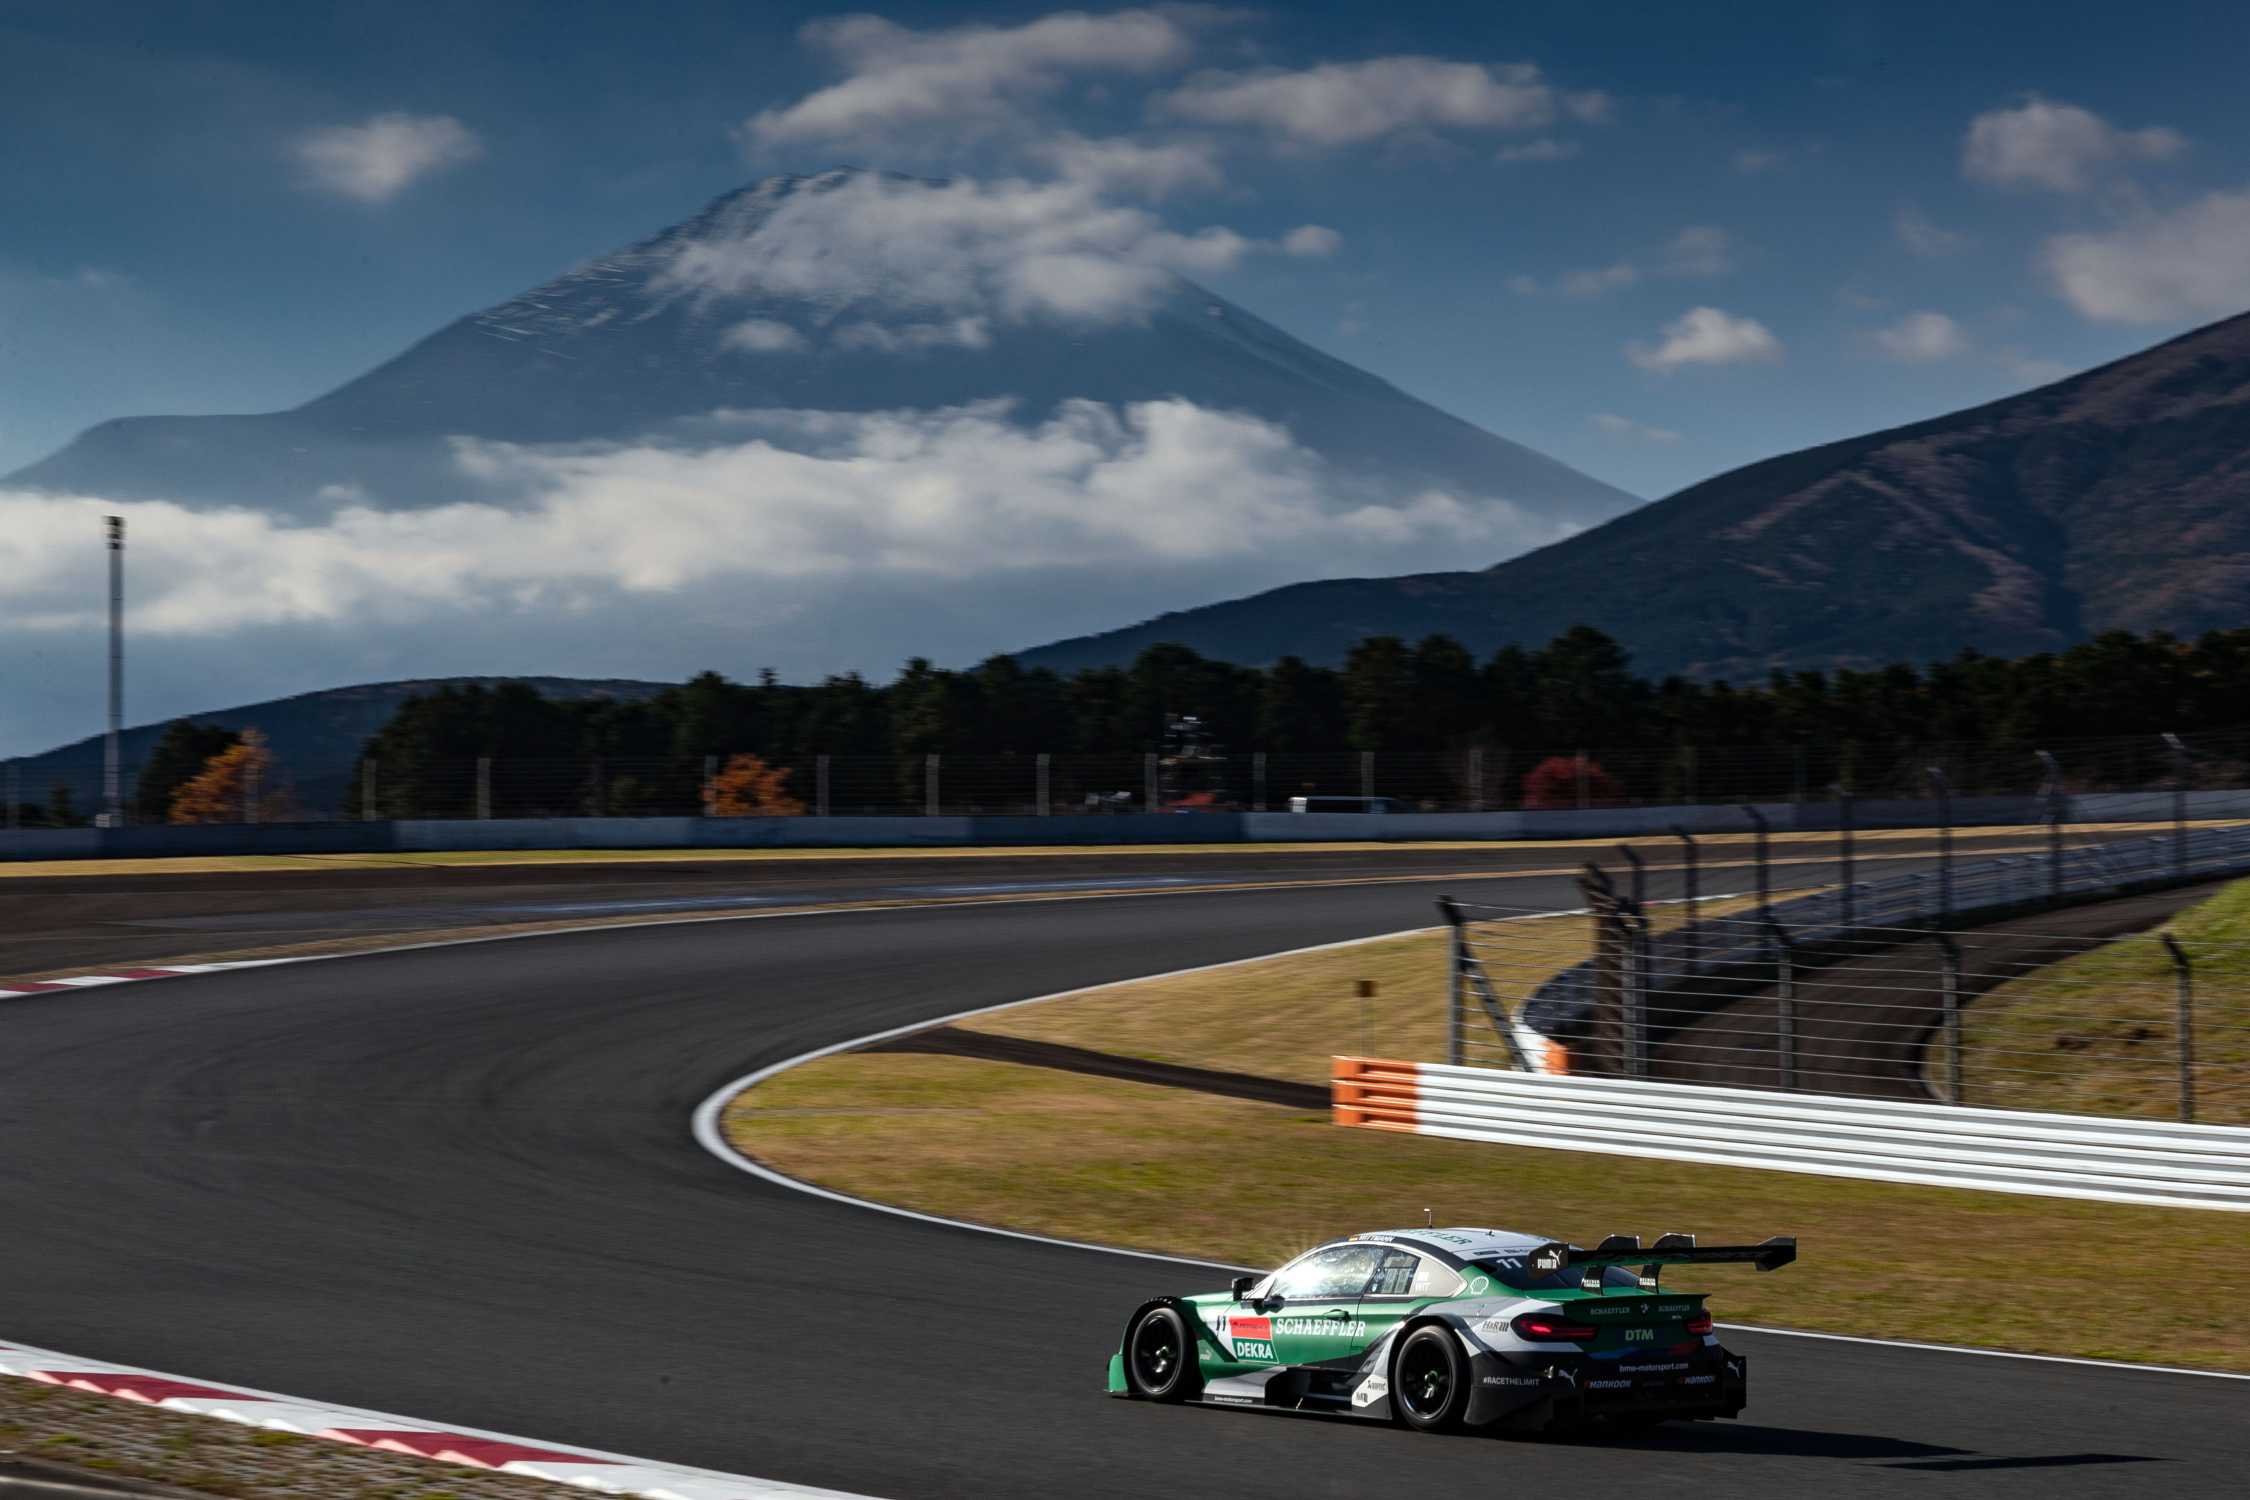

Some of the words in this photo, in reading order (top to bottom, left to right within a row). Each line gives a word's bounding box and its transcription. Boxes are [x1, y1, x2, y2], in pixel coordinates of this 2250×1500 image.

[1496, 1258, 1522, 1269] 11
[1276, 1318, 1366, 1337] SCHAEFFLER
[1625, 1329, 1654, 1341] DTM
[1237, 1341, 1273, 1359] DEKRA
[1483, 1376, 1540, 1387] #RACETHELIMIT
